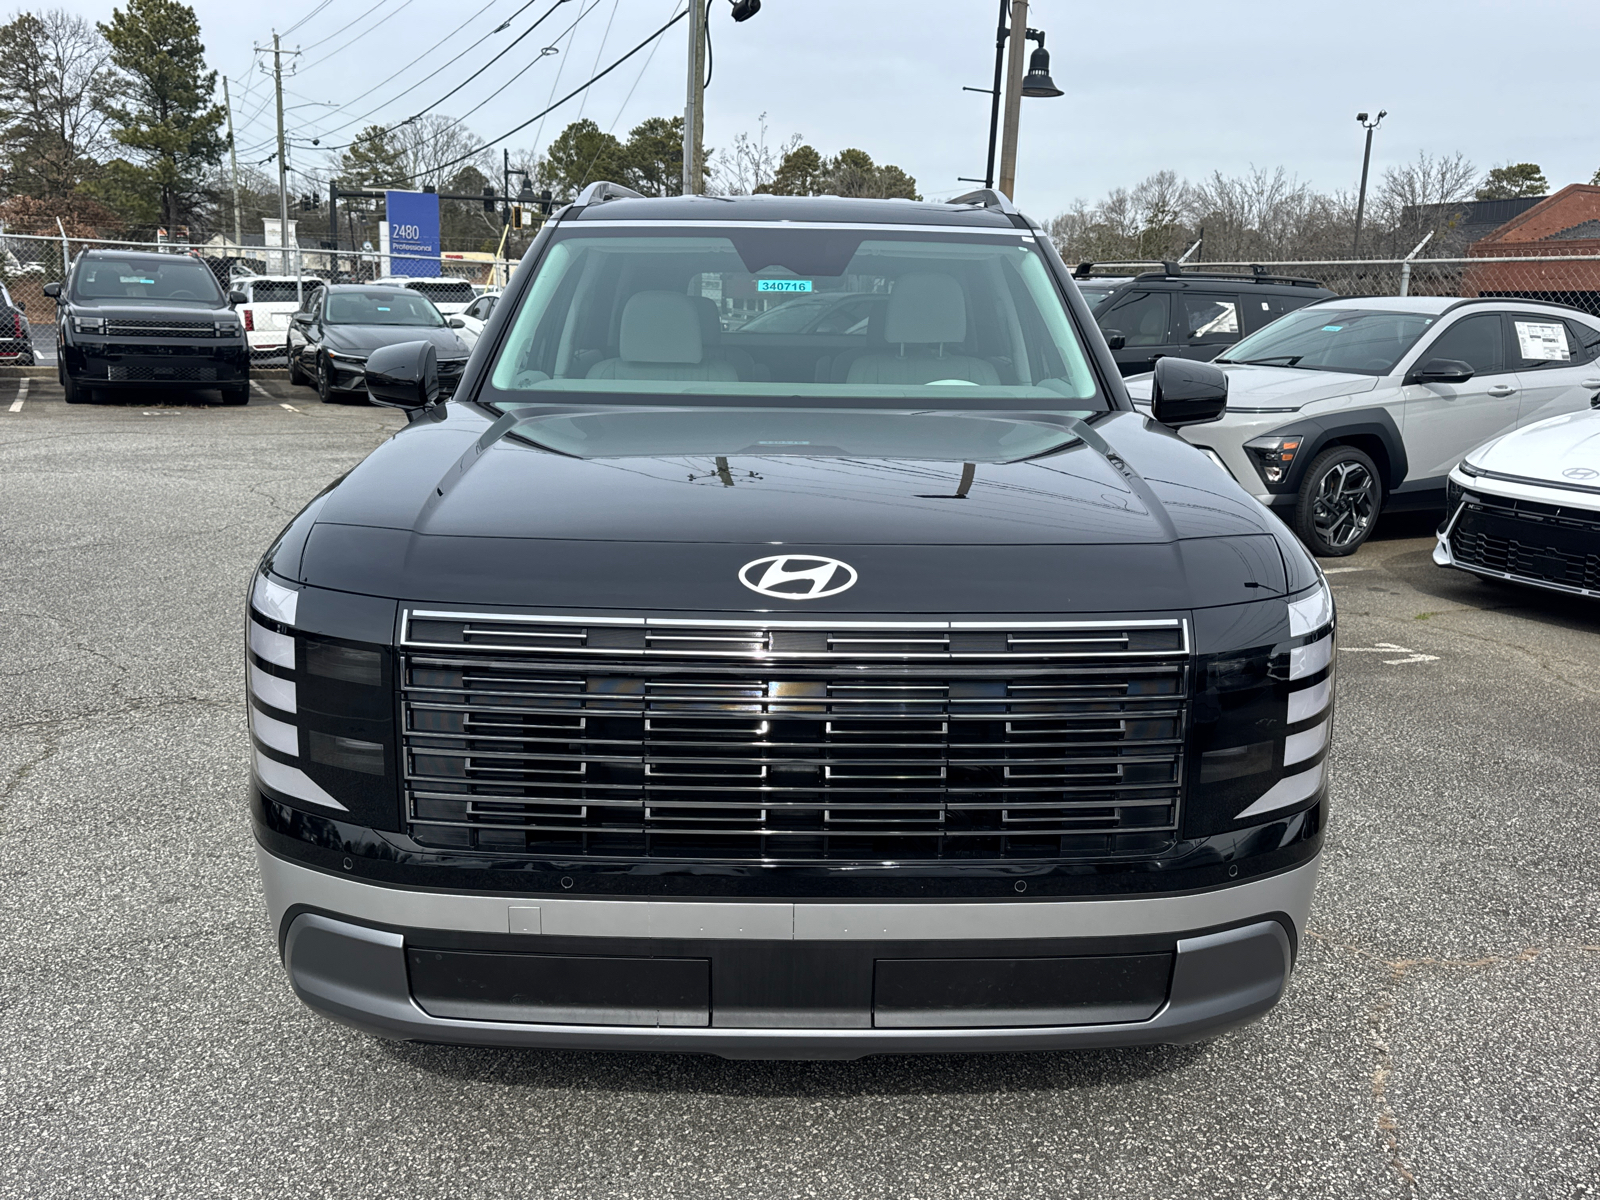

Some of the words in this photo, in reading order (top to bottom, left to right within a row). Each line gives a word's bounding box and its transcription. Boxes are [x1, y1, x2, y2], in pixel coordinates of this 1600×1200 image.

[393, 224, 419, 239] 2480
[393, 243, 432, 251] Professional
[762, 282, 806, 291] 340716
